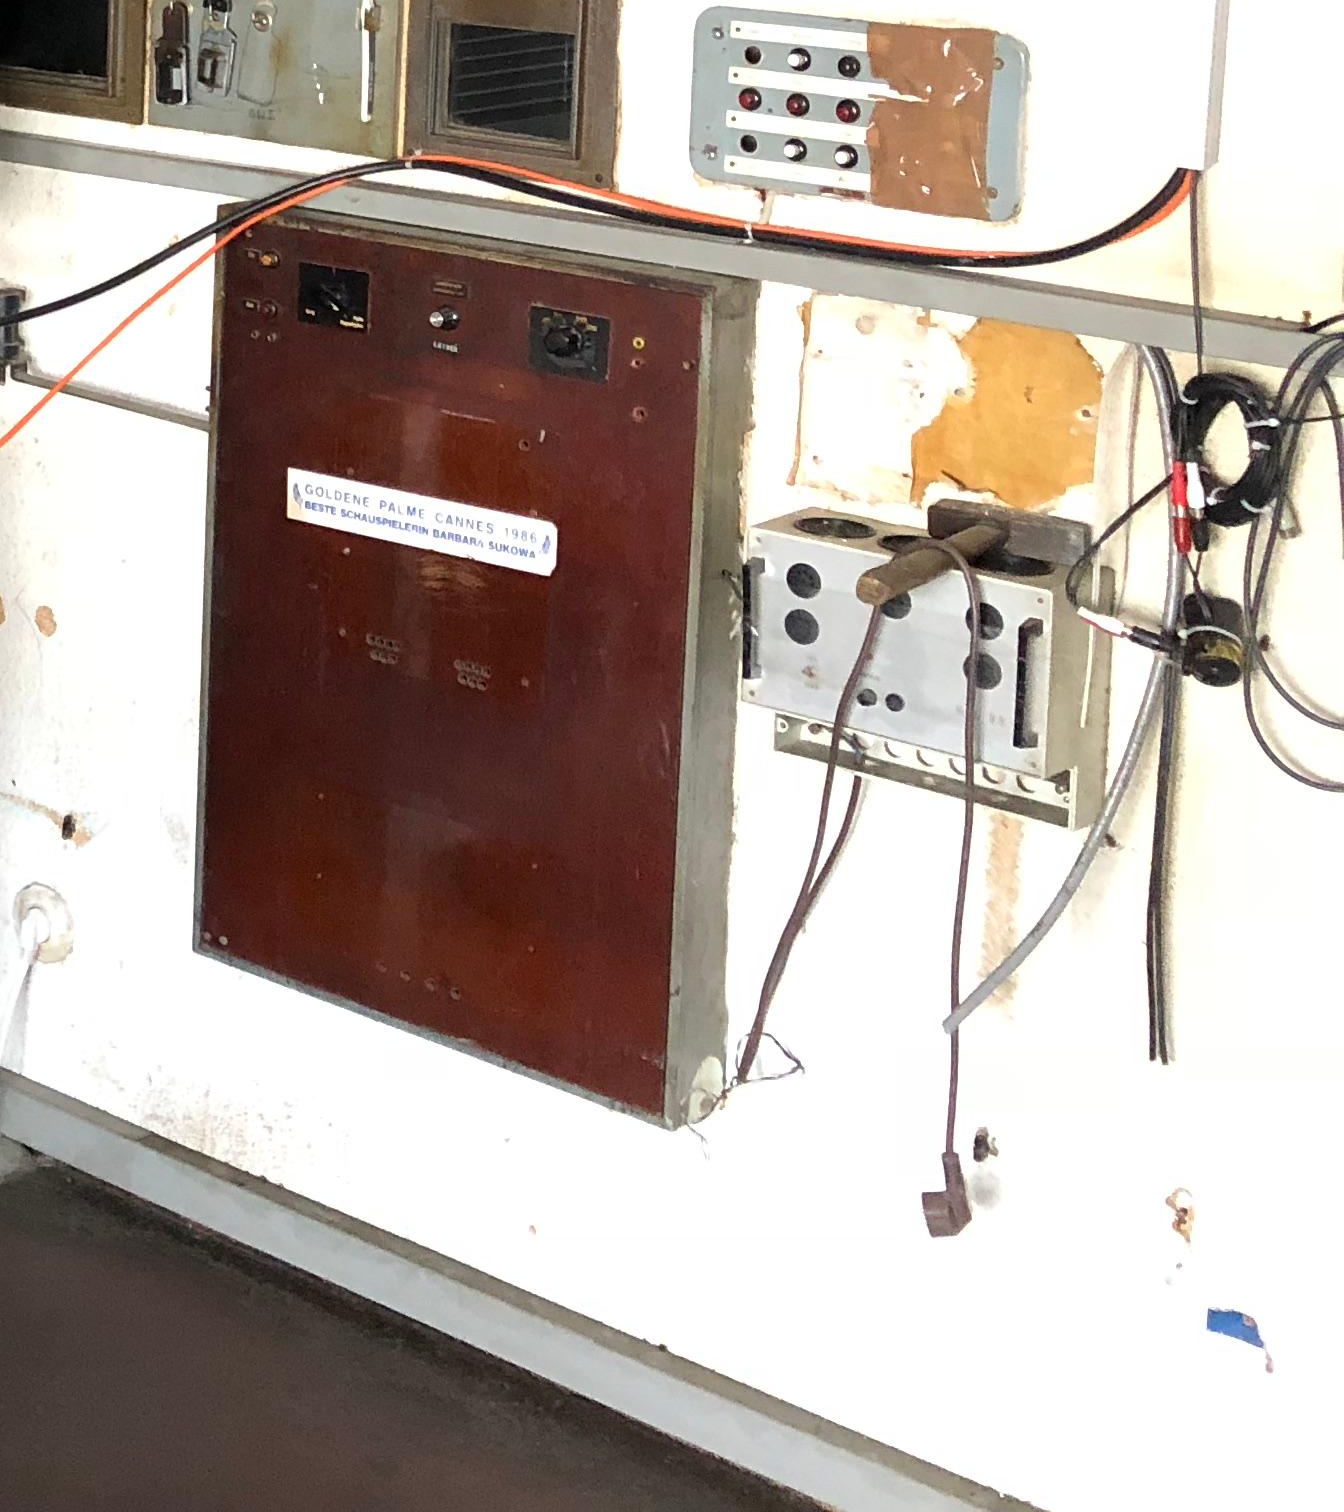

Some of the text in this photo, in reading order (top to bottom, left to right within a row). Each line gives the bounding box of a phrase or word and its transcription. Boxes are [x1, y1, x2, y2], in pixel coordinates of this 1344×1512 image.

[304, 483, 539, 544] GOLDENE PALME CANNES 1986
[304, 500, 537, 560] BESTE SCHAUSPIELERIN BARBARA SUKOWA
